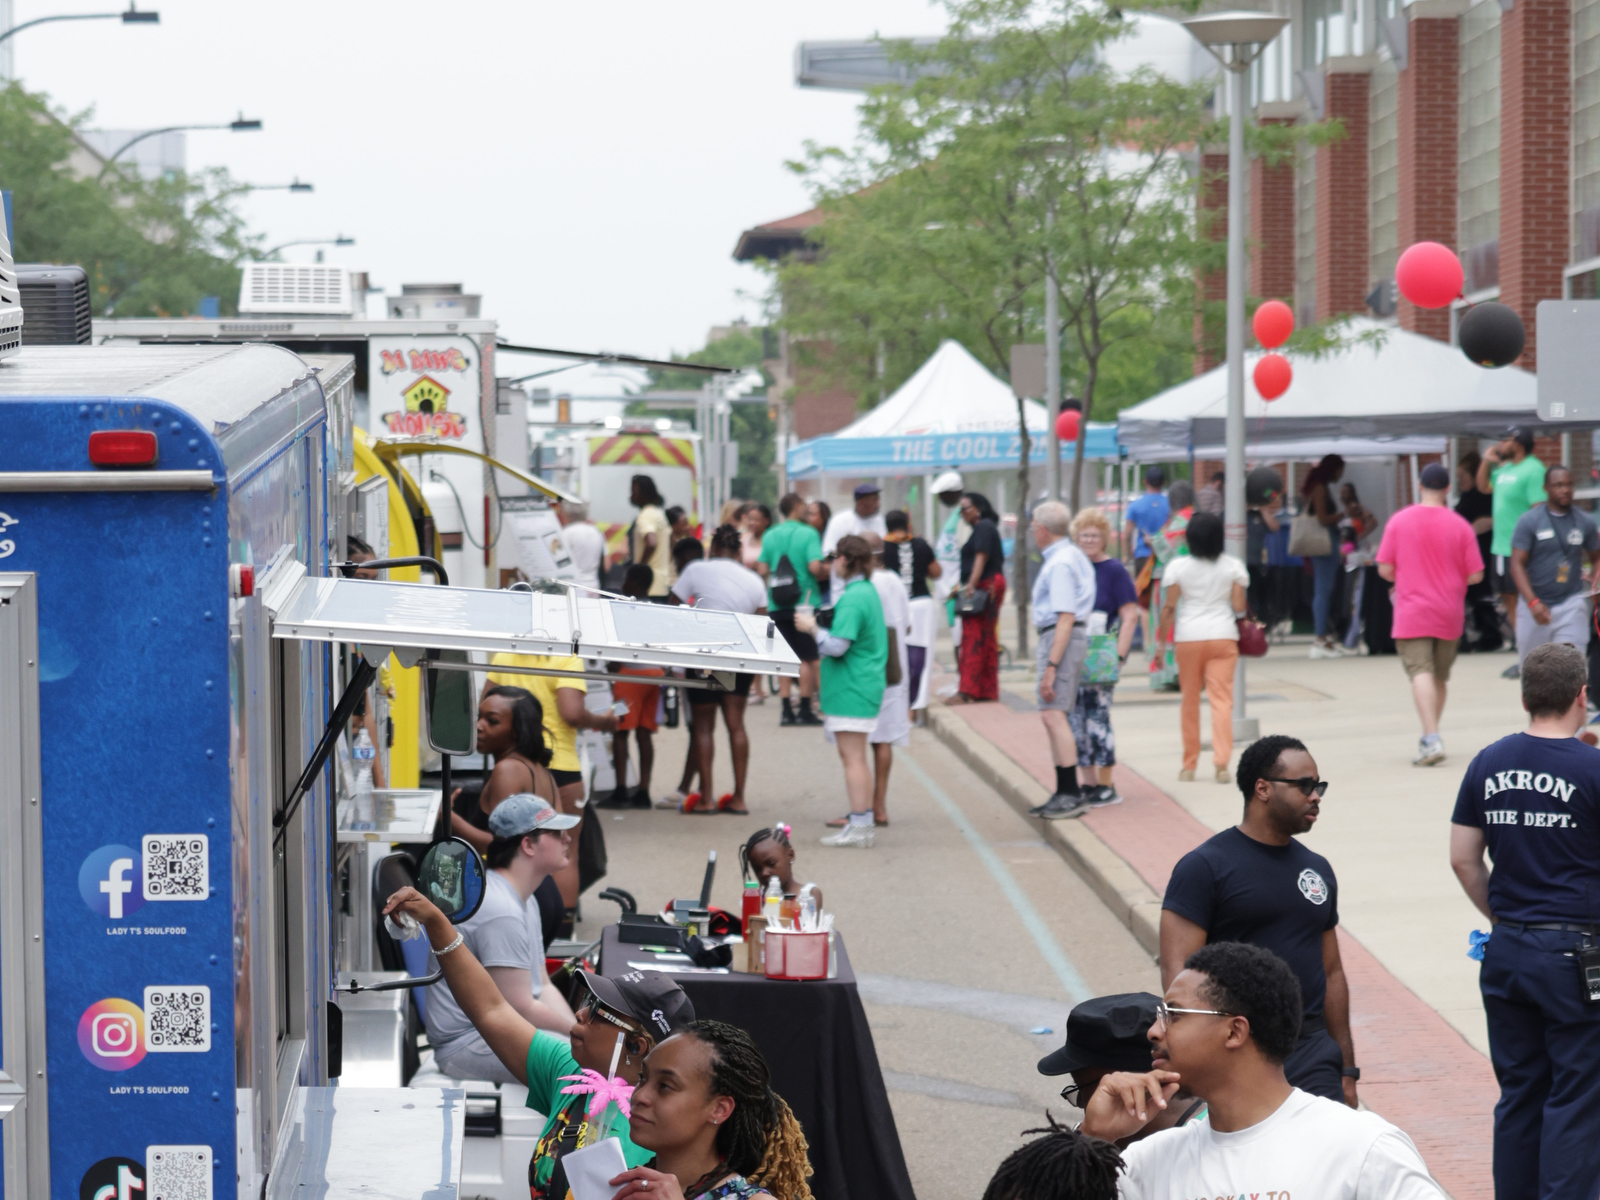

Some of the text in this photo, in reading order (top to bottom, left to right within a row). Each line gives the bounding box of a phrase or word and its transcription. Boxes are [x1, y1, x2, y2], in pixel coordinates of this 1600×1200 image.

[891, 438, 936, 463] THE
[941, 435, 1000, 461] COOL
[1484, 769, 1577, 803] AKRON
[1523, 811, 1578, 828] DEPT.
[106, 926, 187, 935] LADY T'S SOULFOOD
[109, 1086, 190, 1095] LADY T'S SOULFOOD
